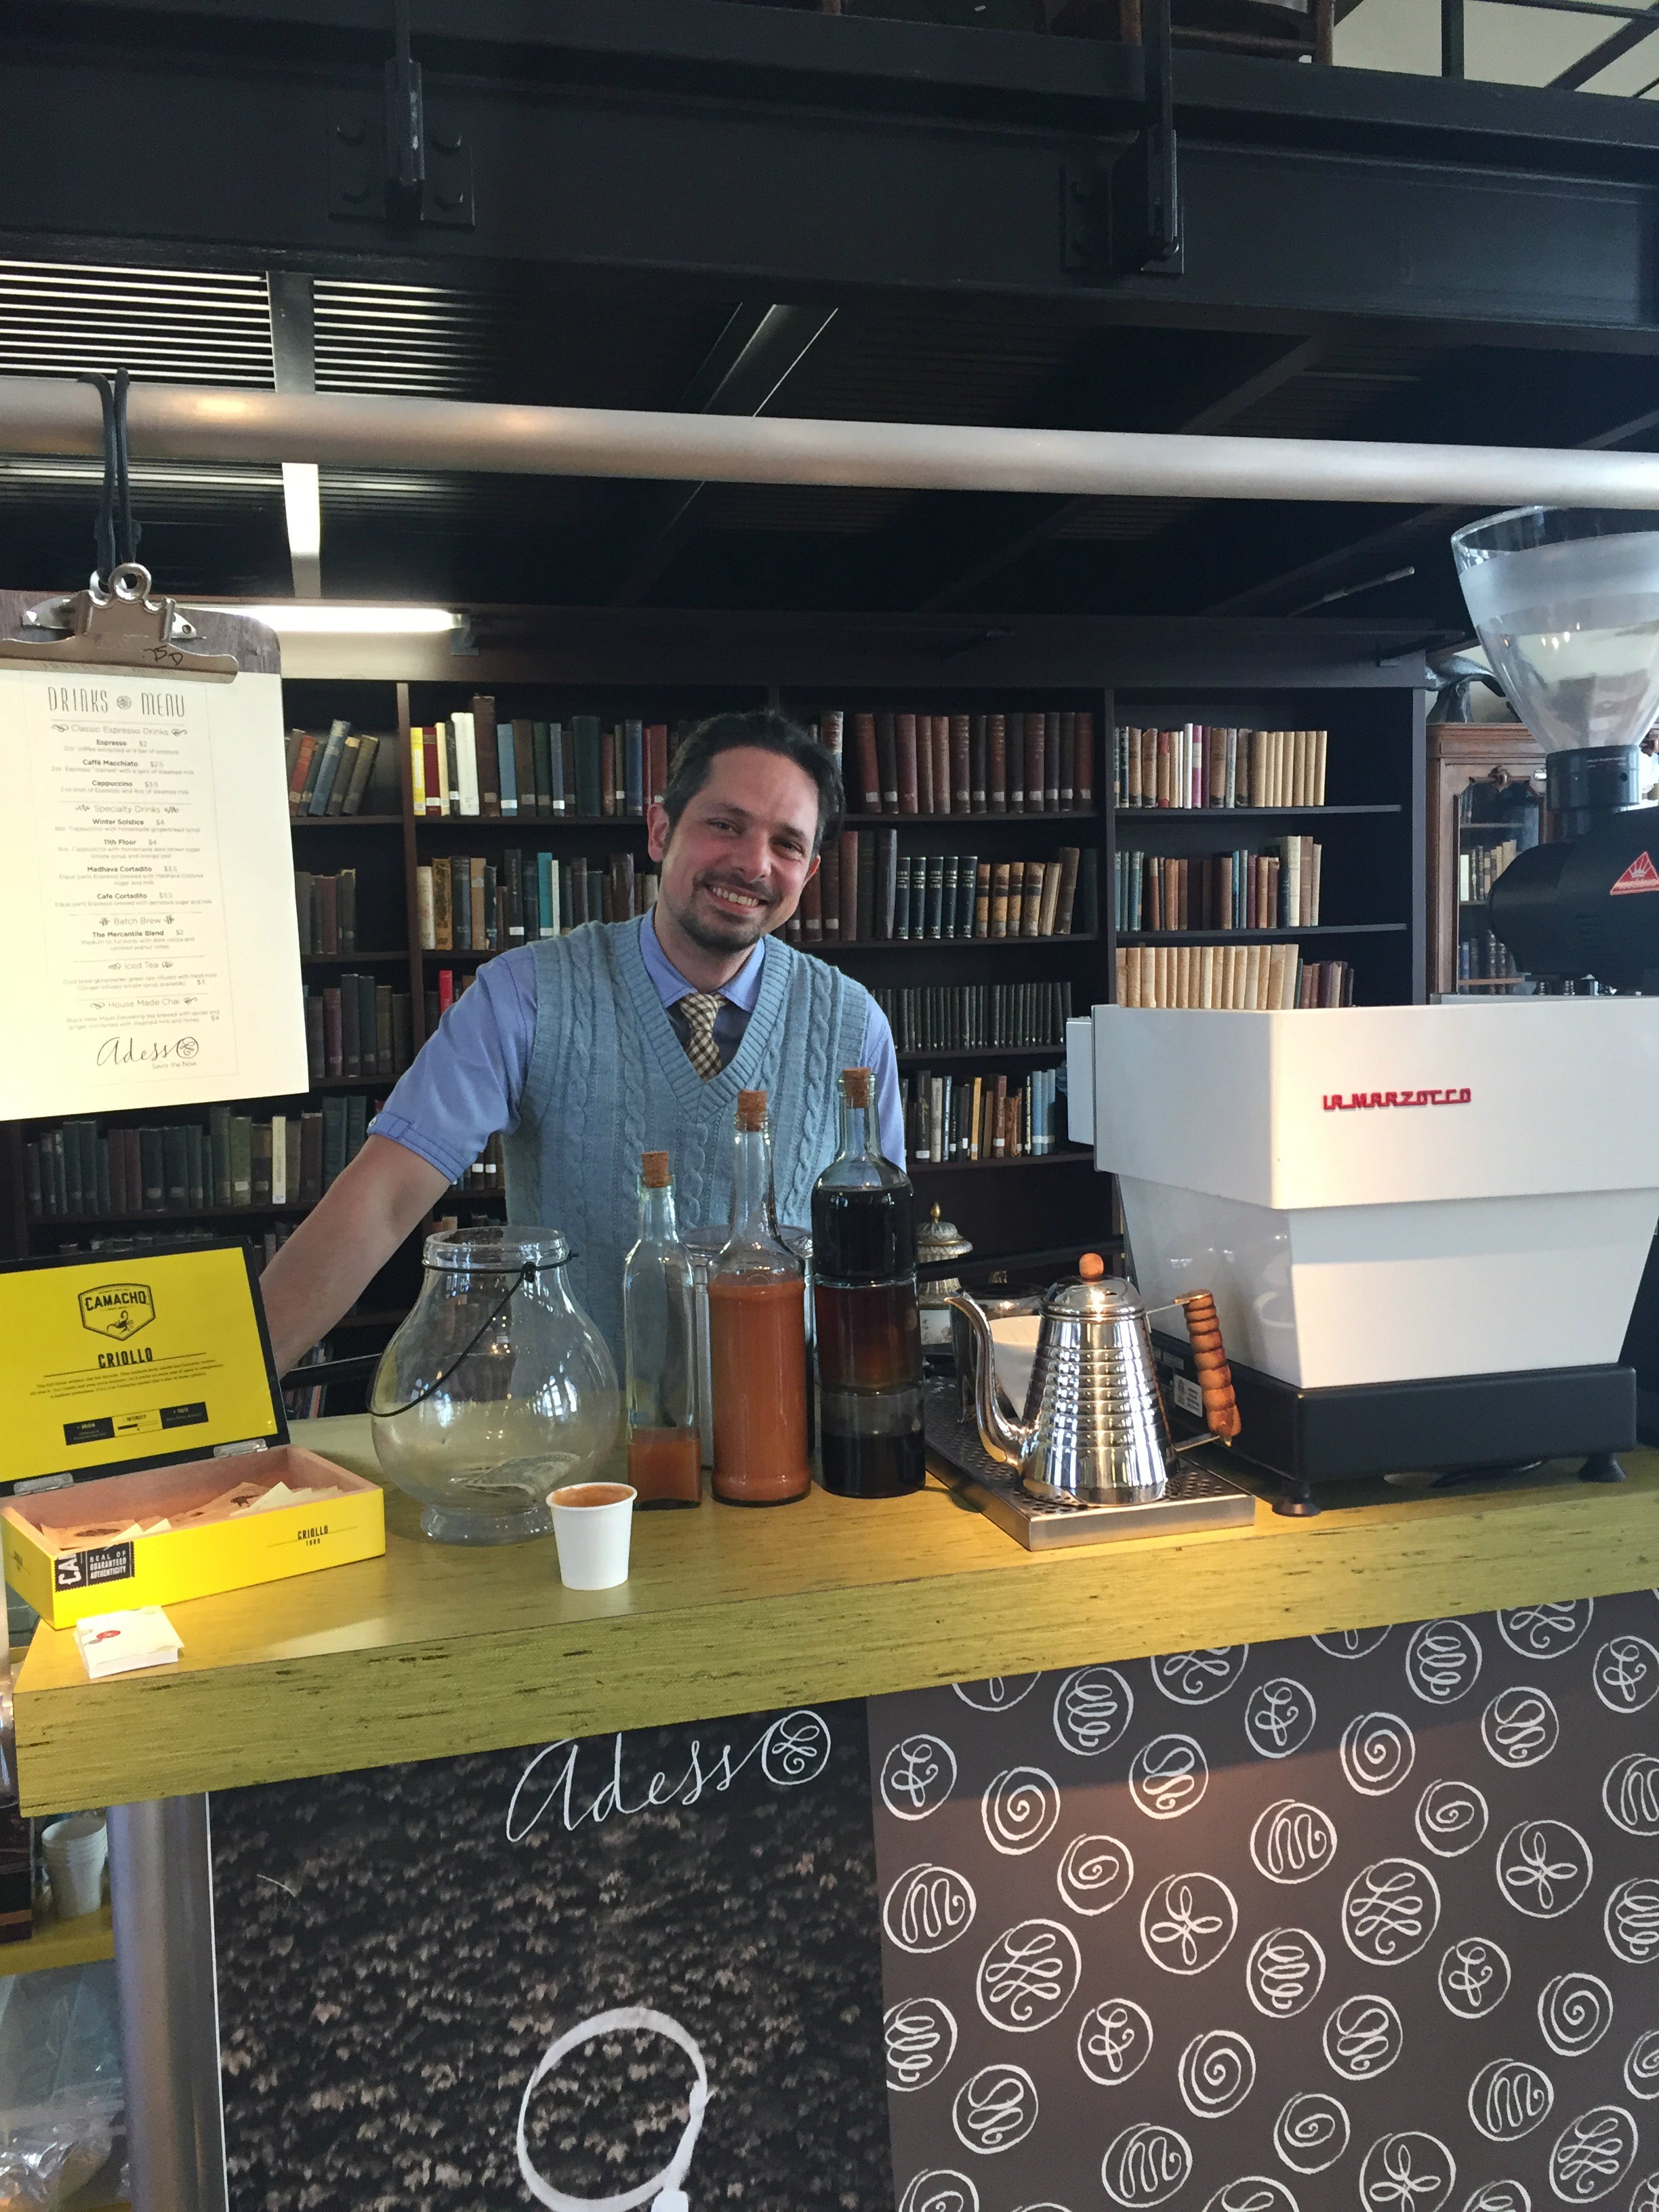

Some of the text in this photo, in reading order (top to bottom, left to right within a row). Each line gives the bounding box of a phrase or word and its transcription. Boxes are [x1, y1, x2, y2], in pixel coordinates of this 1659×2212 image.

[48, 687, 185, 717] DRINKS MENU
[71, 724, 169, 736] Classic Espresso Drinks
[92, 779, 132, 787] Cappuccino
[94, 805, 132, 814] Specialty
[85, 1290, 147, 1311] CAMACHO
[98, 1347, 153, 1370] CRIOLLO
[298, 1525, 329, 1540] CRIOLLO
[89, 1550, 127, 1563] SEAL OF
[89, 1557, 127, 1572] GUARANTEED
[90, 1565, 126, 1580] AUTHENTICITY
